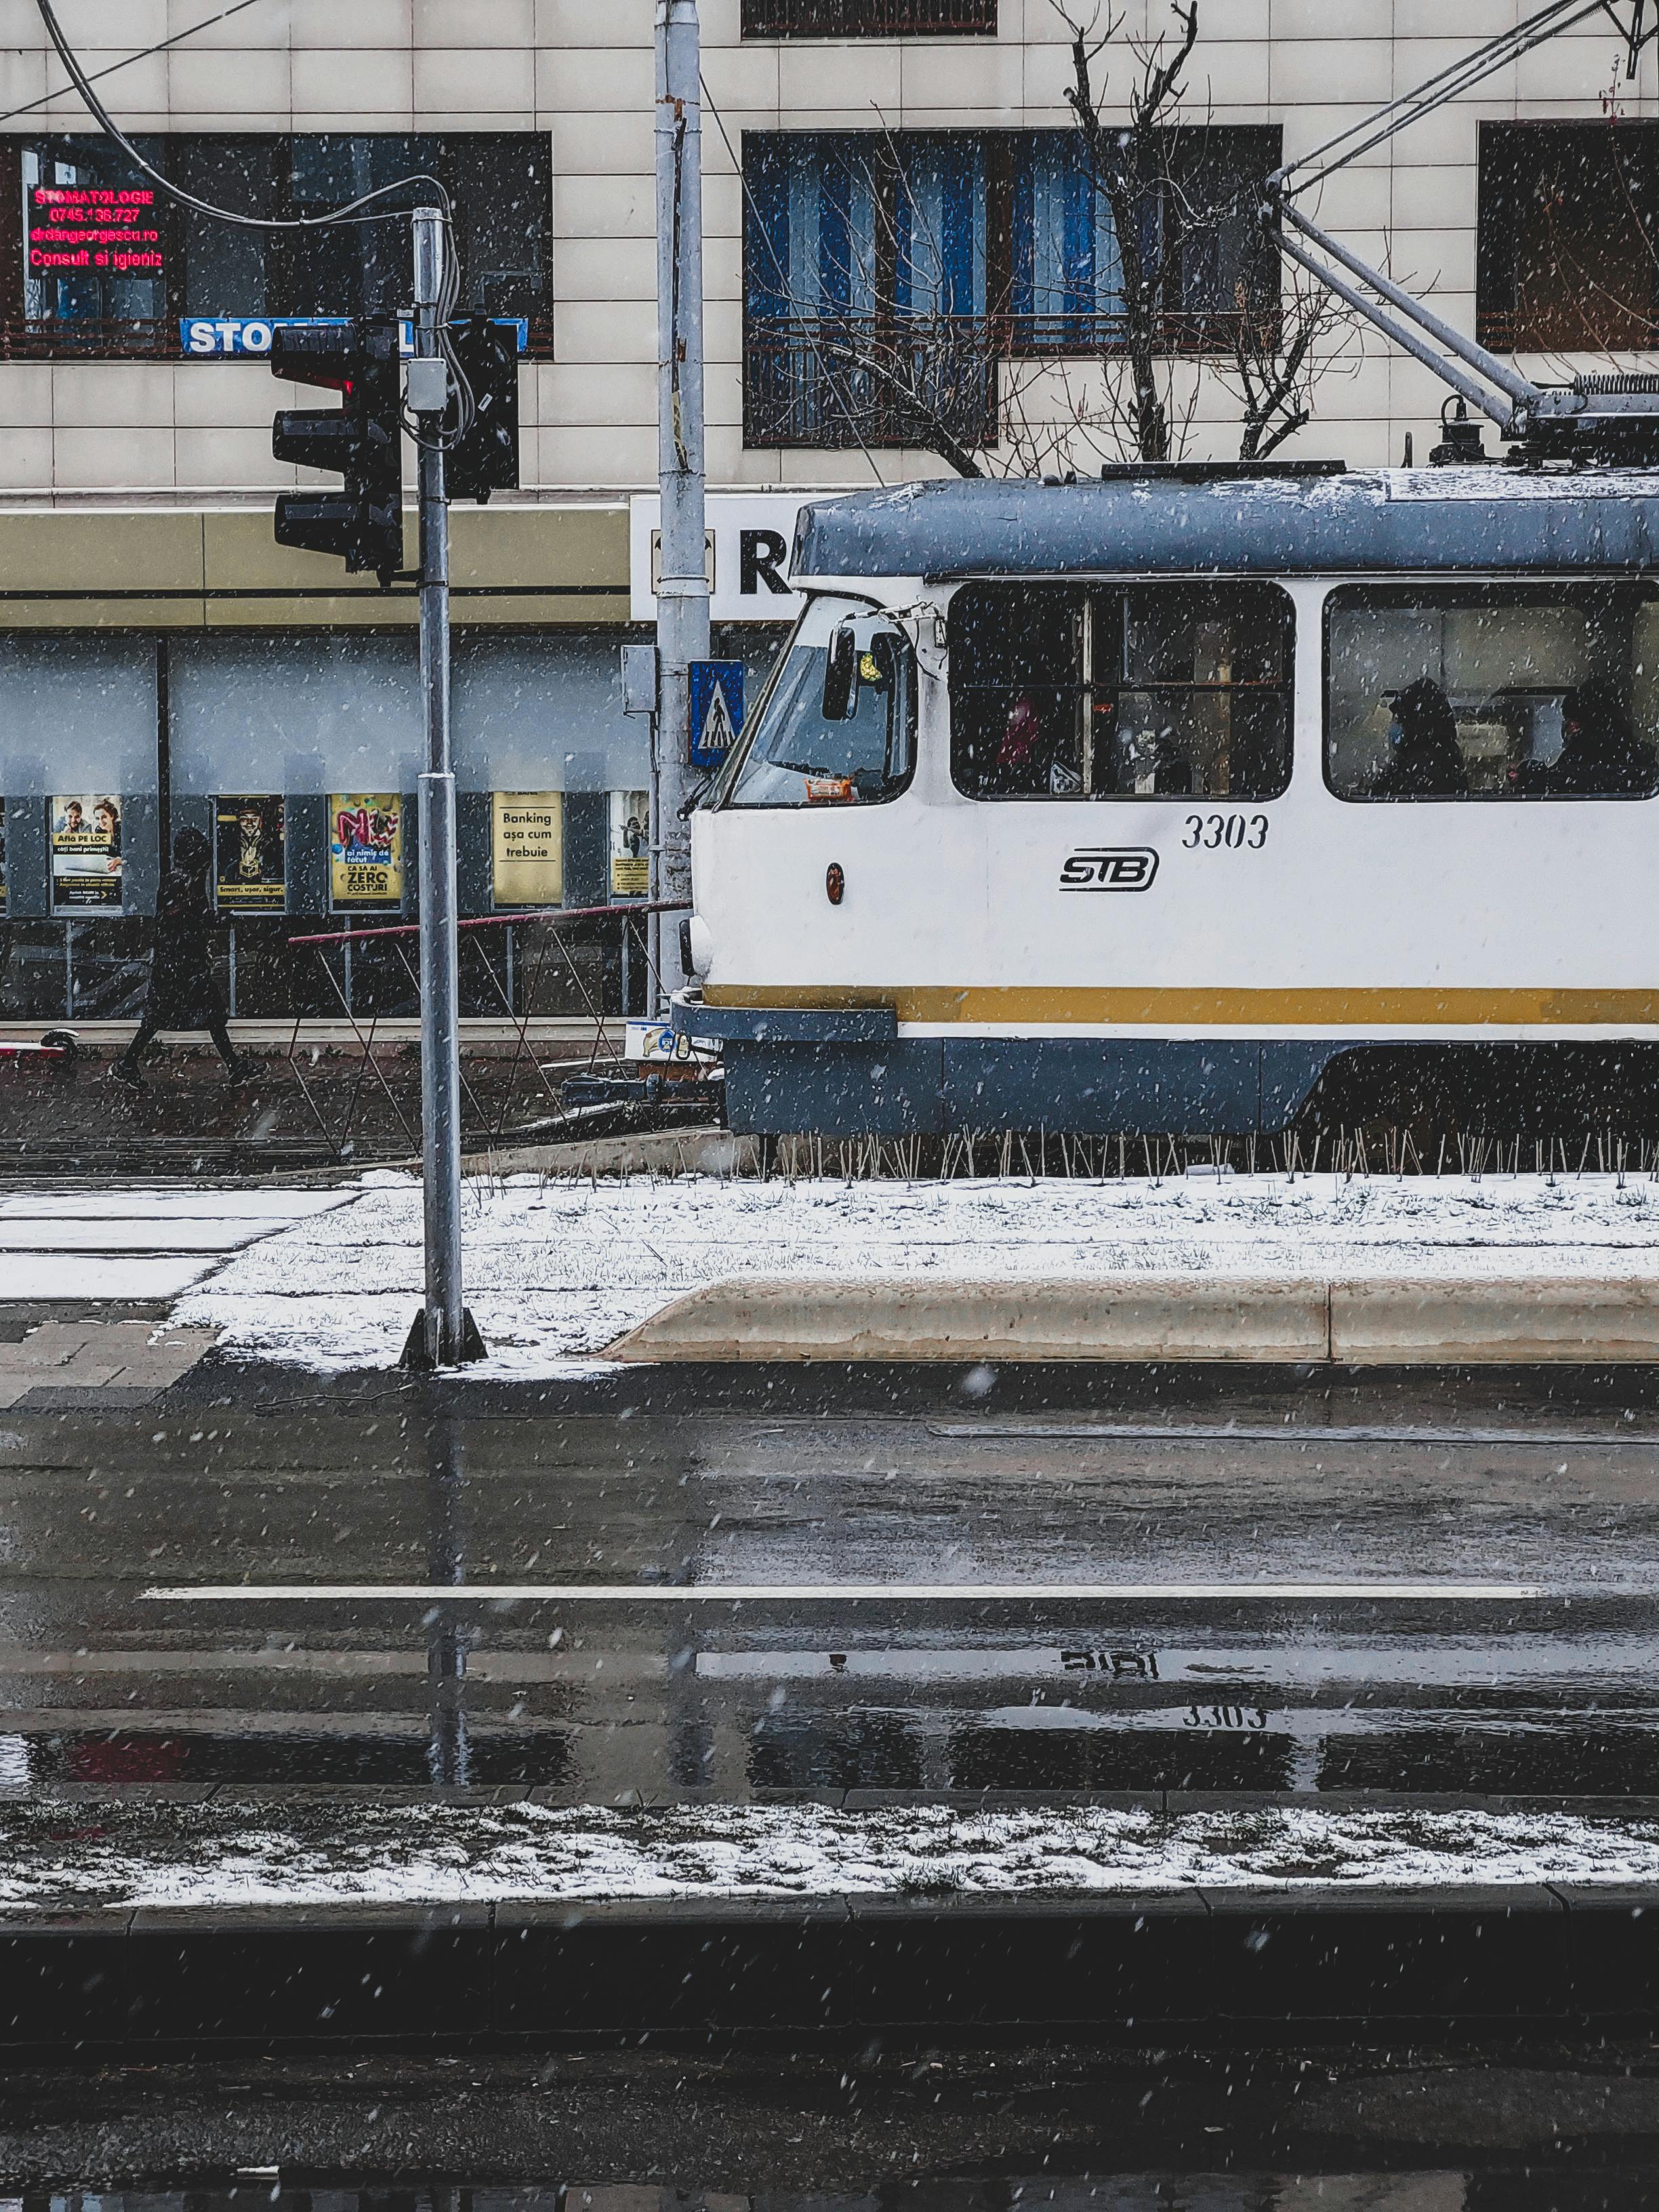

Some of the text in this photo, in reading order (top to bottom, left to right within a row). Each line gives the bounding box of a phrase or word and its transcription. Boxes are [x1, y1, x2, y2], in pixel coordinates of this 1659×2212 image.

[35, 190, 154, 205] STOMATOLOGIE
[30, 249, 89, 266] Consult
[94, 249, 109, 266] si
[504, 812, 552, 826] Banking
[504, 831, 552, 841] așa cum
[1182, 815, 1269, 848] 3303
[506, 845, 548, 857] trebuie
[1059, 856, 1149, 883] STB
[347, 872, 388, 884] ZERO
[347, 884, 388, 892] COSTURI
